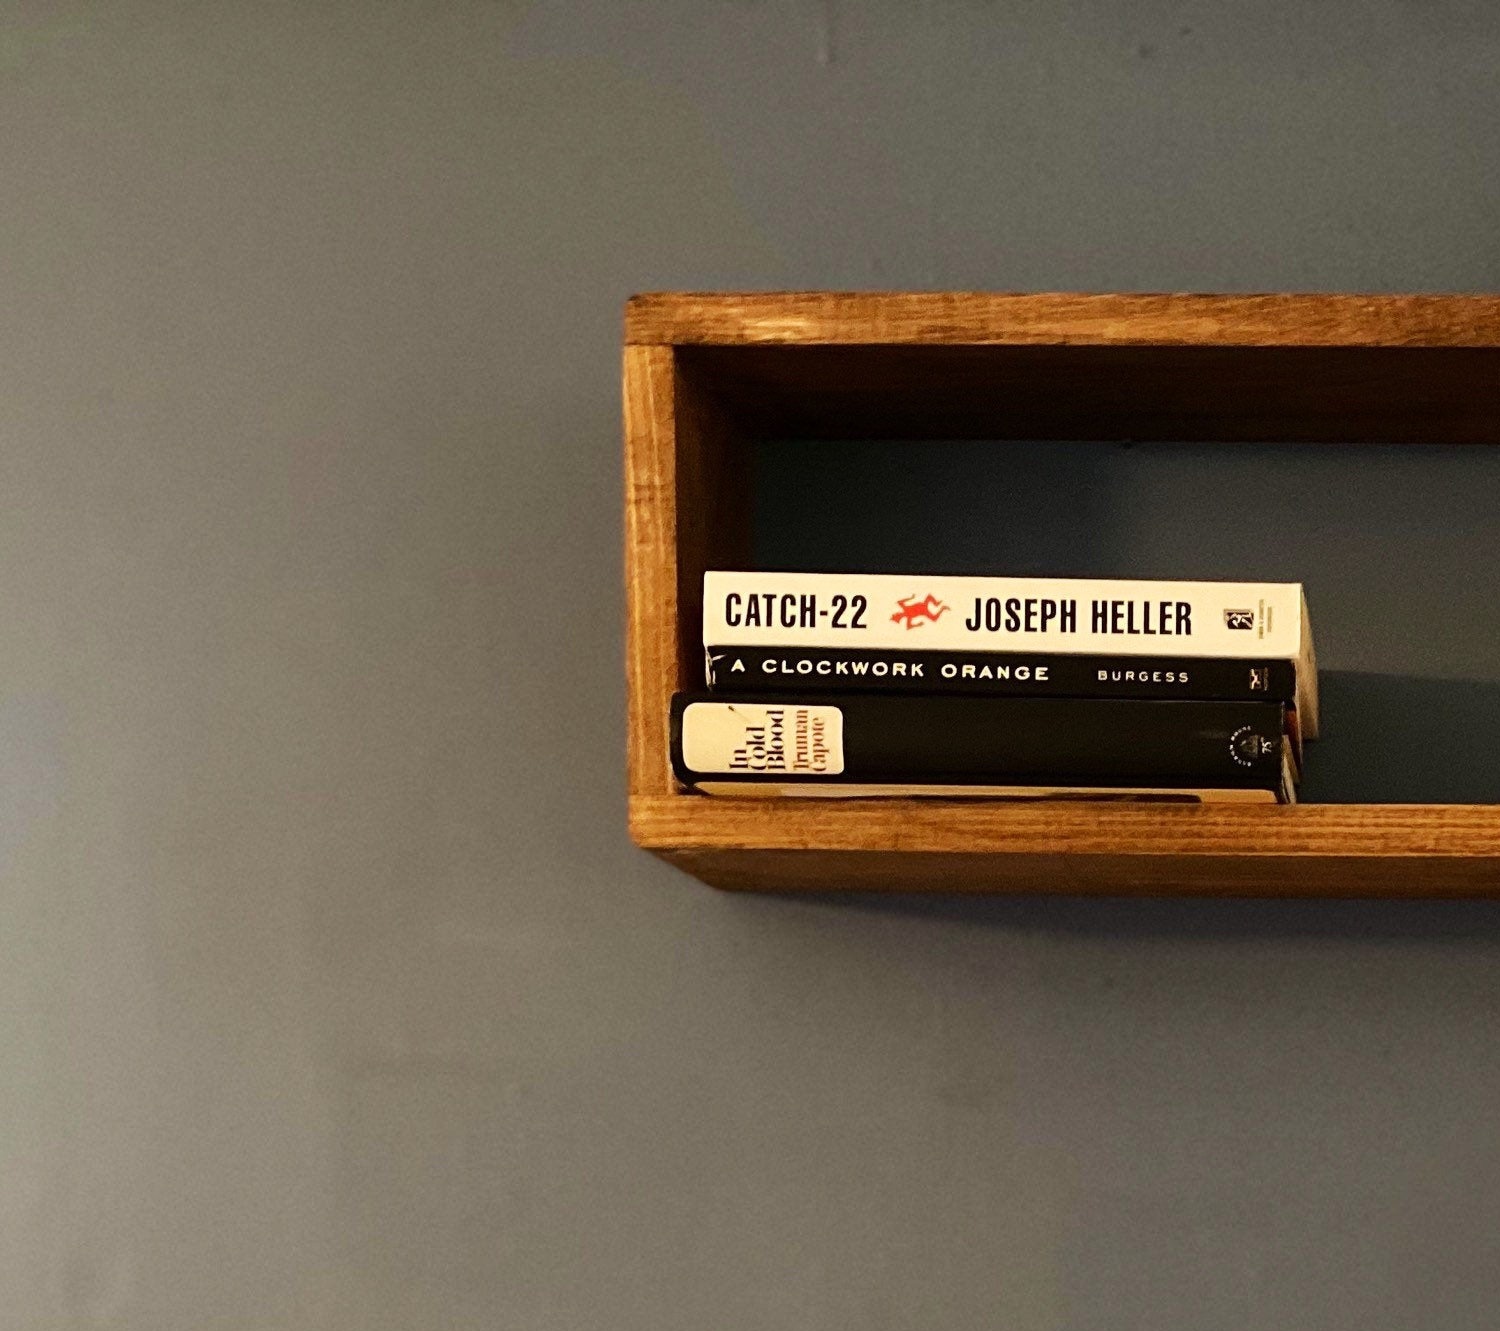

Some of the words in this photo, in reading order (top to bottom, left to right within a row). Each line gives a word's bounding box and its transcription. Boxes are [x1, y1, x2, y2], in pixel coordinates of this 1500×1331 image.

[725, 592, 868, 629] CATCH-22
[965, 597, 1077, 633] JOSEPH
[1091, 600, 1192, 635] HELLER
[730, 658, 746, 673] A
[761, 659, 924, 677] CLOCKWORK
[940, 663, 1049, 681] ORANGE
[1097, 670, 1189, 683] BURGESS
[746, 726, 767, 770] Cold
[766, 710, 786, 770] Blood
[793, 709, 810, 770] Truman
[812, 717, 830, 772] Capote
[729, 749, 748, 769] In
